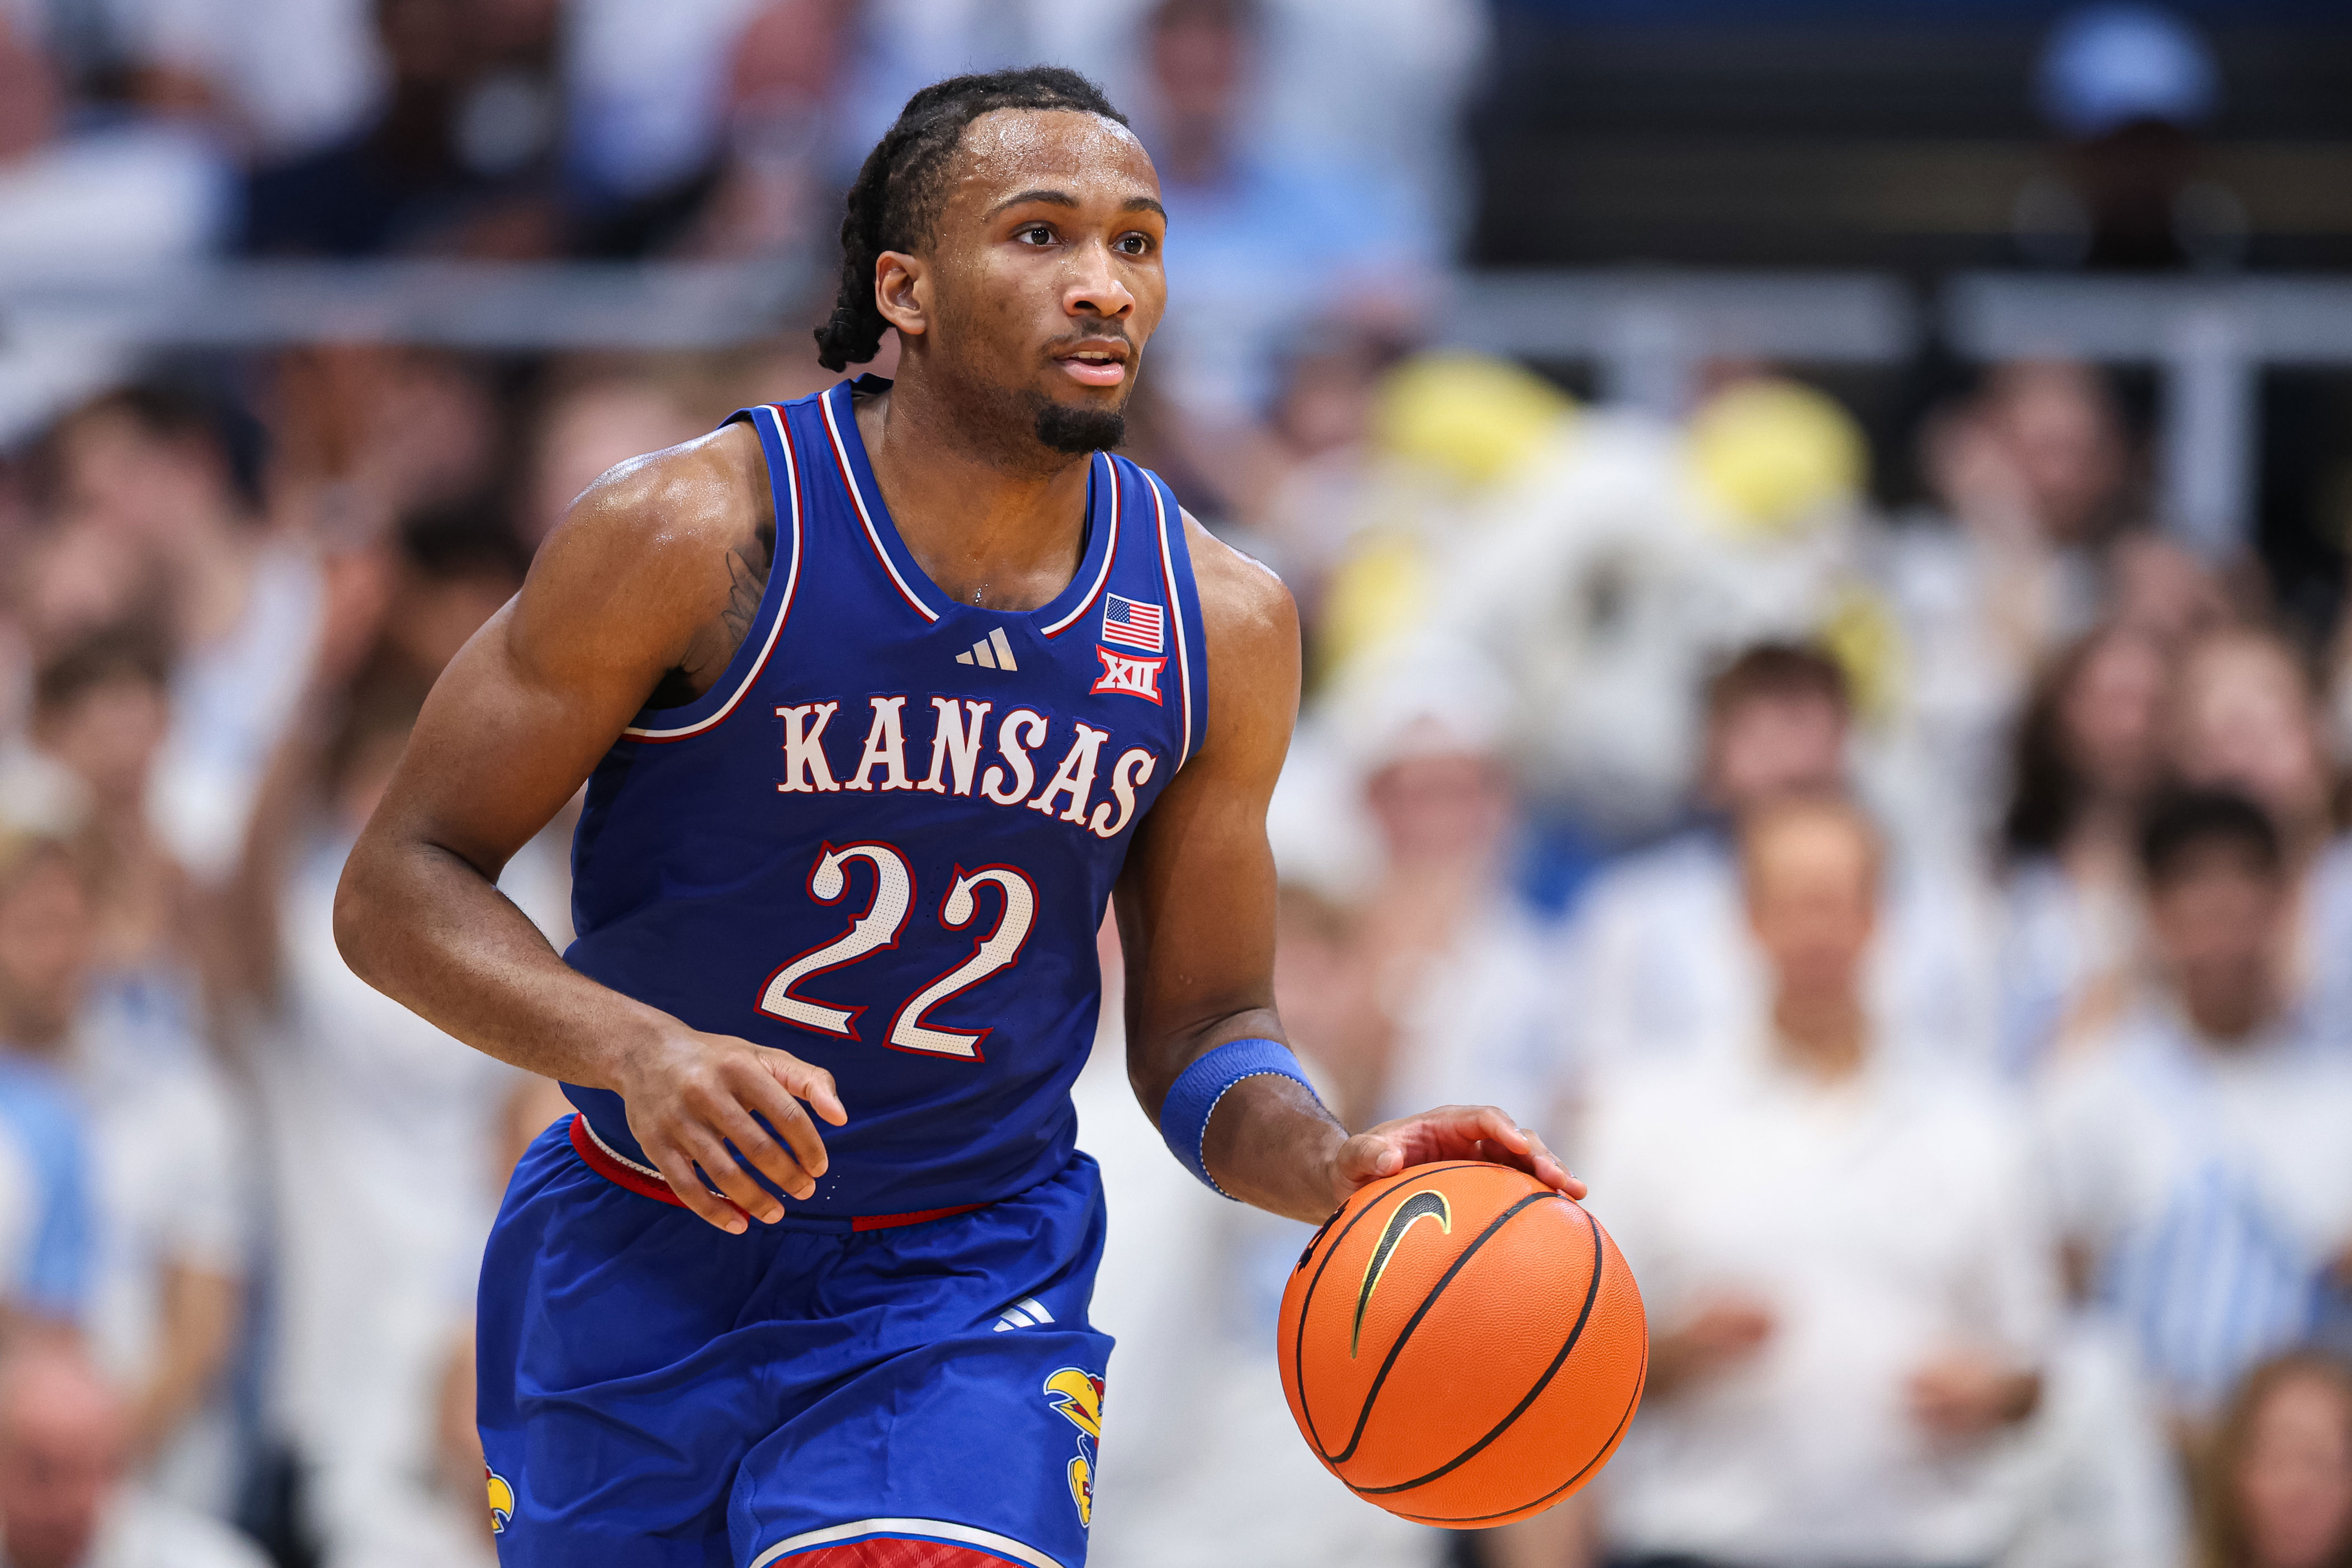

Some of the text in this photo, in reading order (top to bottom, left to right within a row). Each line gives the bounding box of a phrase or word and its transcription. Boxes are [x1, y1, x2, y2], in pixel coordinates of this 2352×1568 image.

[1095, 649, 1163, 701] XII
[775, 696, 1158, 839] KANSAS
[754, 840, 1039, 1062] 22
